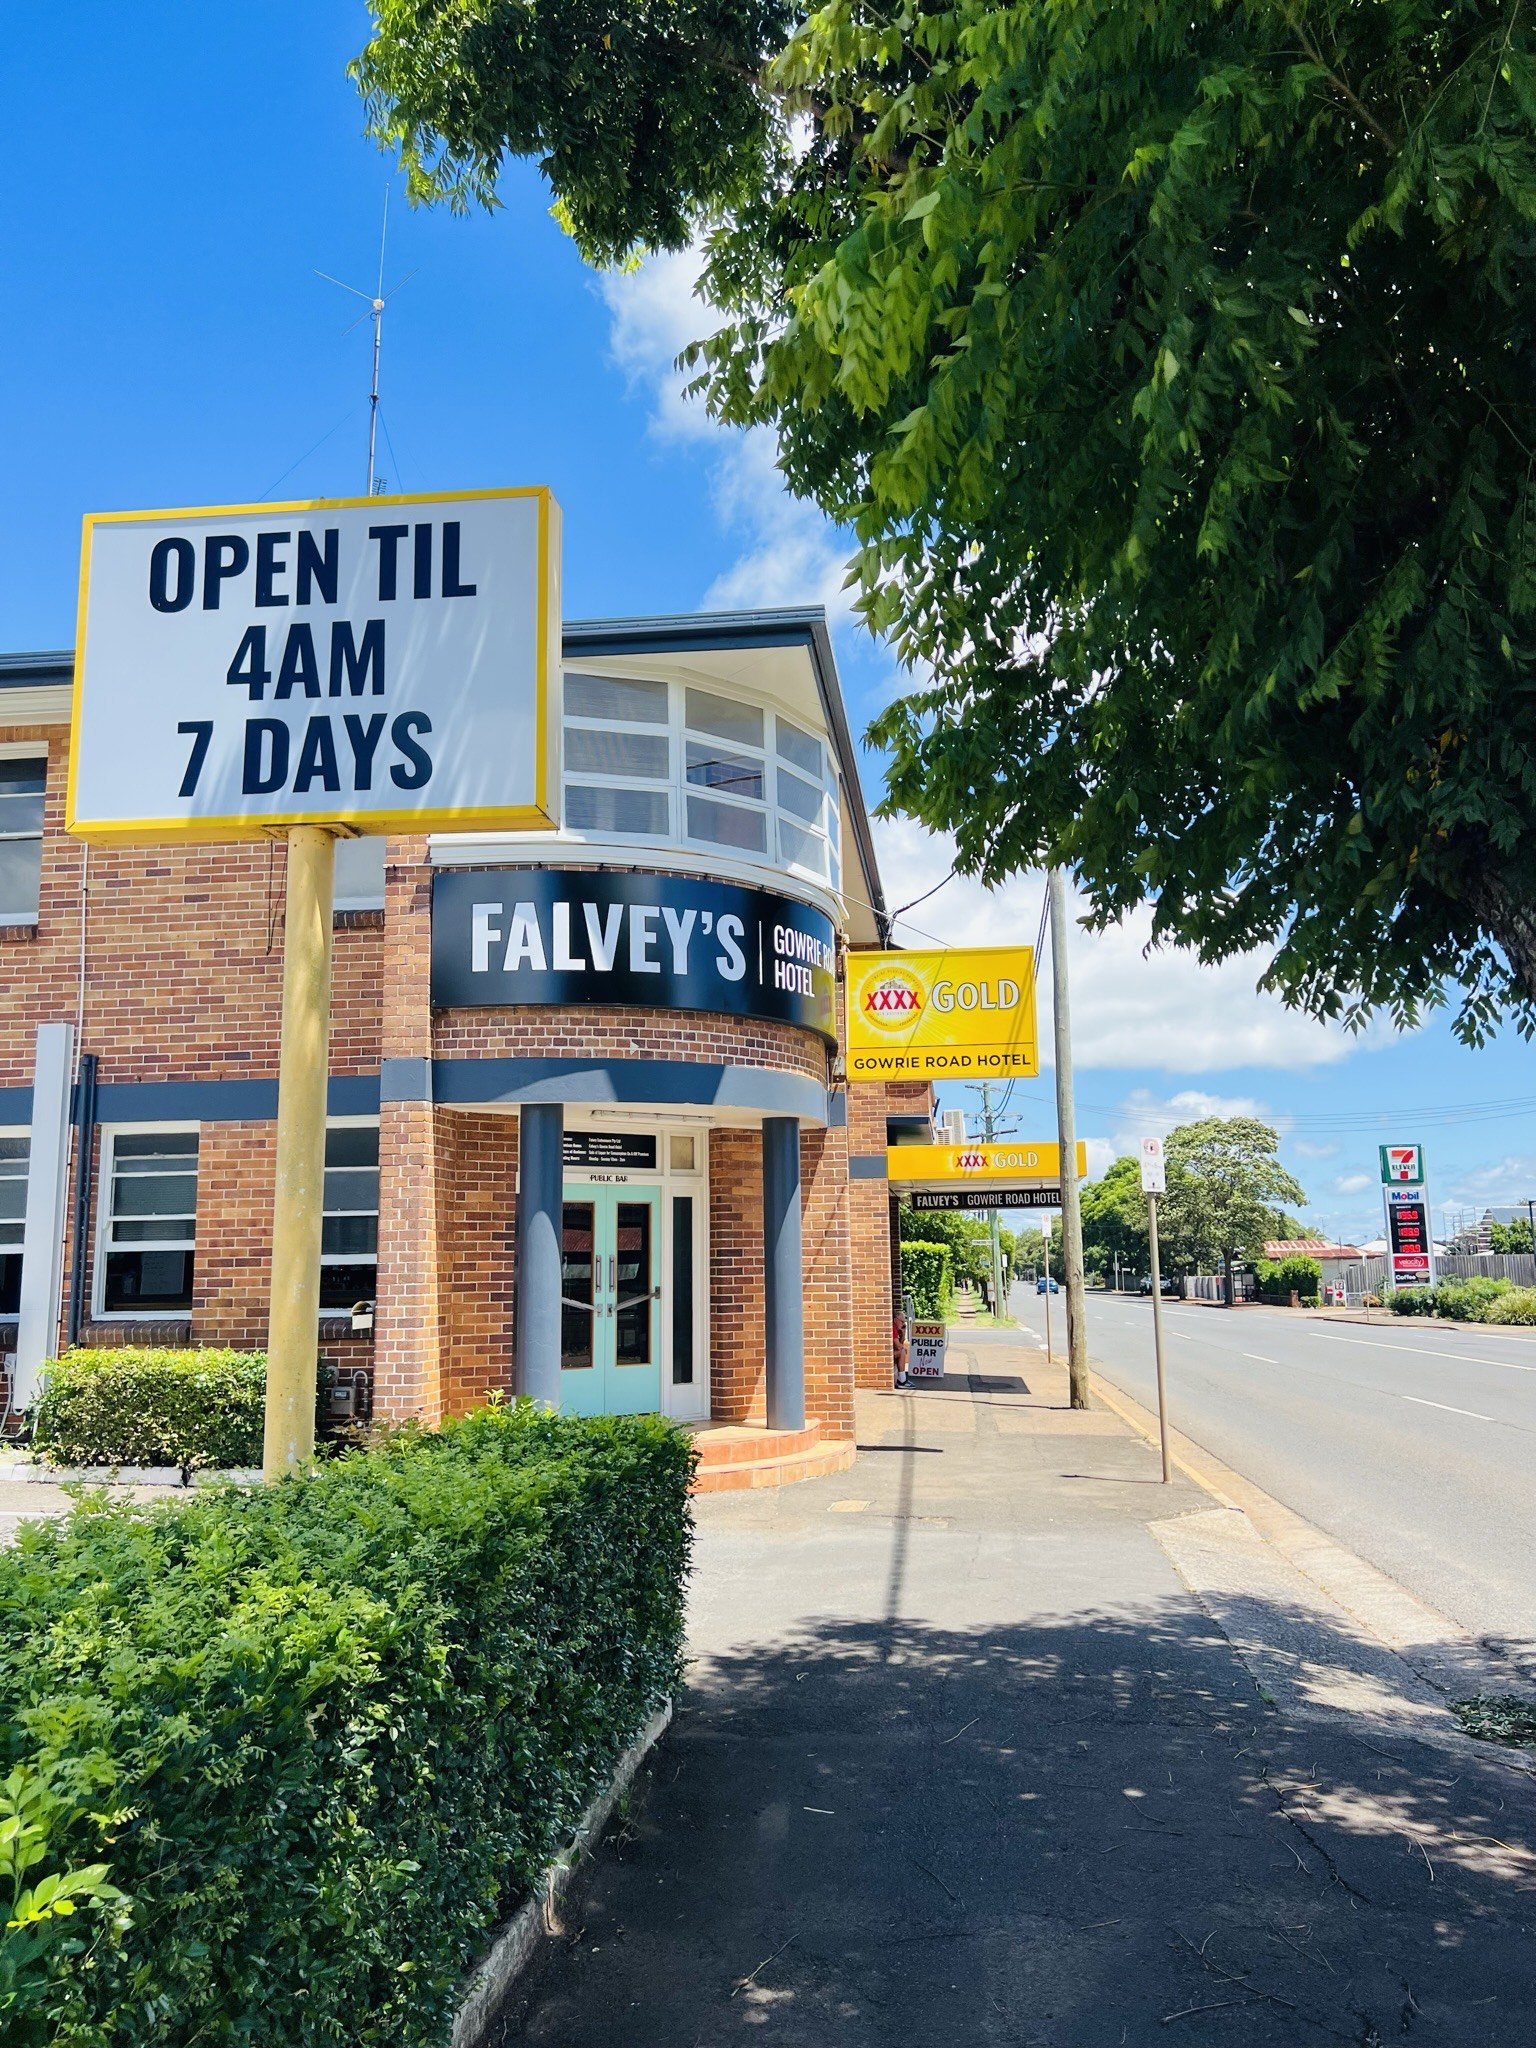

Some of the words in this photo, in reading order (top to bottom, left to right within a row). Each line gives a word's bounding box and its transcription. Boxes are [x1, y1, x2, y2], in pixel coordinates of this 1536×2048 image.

[149, 529, 339, 613] OPEN
[369, 521, 477, 602] TIL
[226, 619, 385, 701] 4AM
[178, 720, 214, 797] 7
[241, 710, 433, 795] DAYS
[471, 901, 747, 982] FALVEY'S
[774, 924, 822, 968] GOWRIE
[774, 959, 816, 998] HOTEL
[865, 990, 922, 1011] XXXX
[932, 979, 1020, 1013] GOLD
[854, 1056, 920, 1070] GOWRIE
[925, 1055, 972, 1068] ROAD
[977, 1053, 1031, 1067] HOTEL
[955, 1155, 989, 1168] XXXX
[994, 1151, 1039, 1168] GOLD
[590, 1174, 613, 1182] PUBLIC
[916, 1194, 960, 1207] FALVEY'S
[967, 1193, 1003, 1206] GOWRIE
[1005, 1192, 1031, 1205] ROAD
[1032, 1192, 1062, 1204] HOTEL
[1391, 1191, 1419, 1201] Mobil
[915, 1325, 941, 1335] XXXX
[911, 1338, 944, 1348] PUBLIC
[916, 1348, 937, 1357] BAR
[912, 1366, 940, 1376] OPEN
